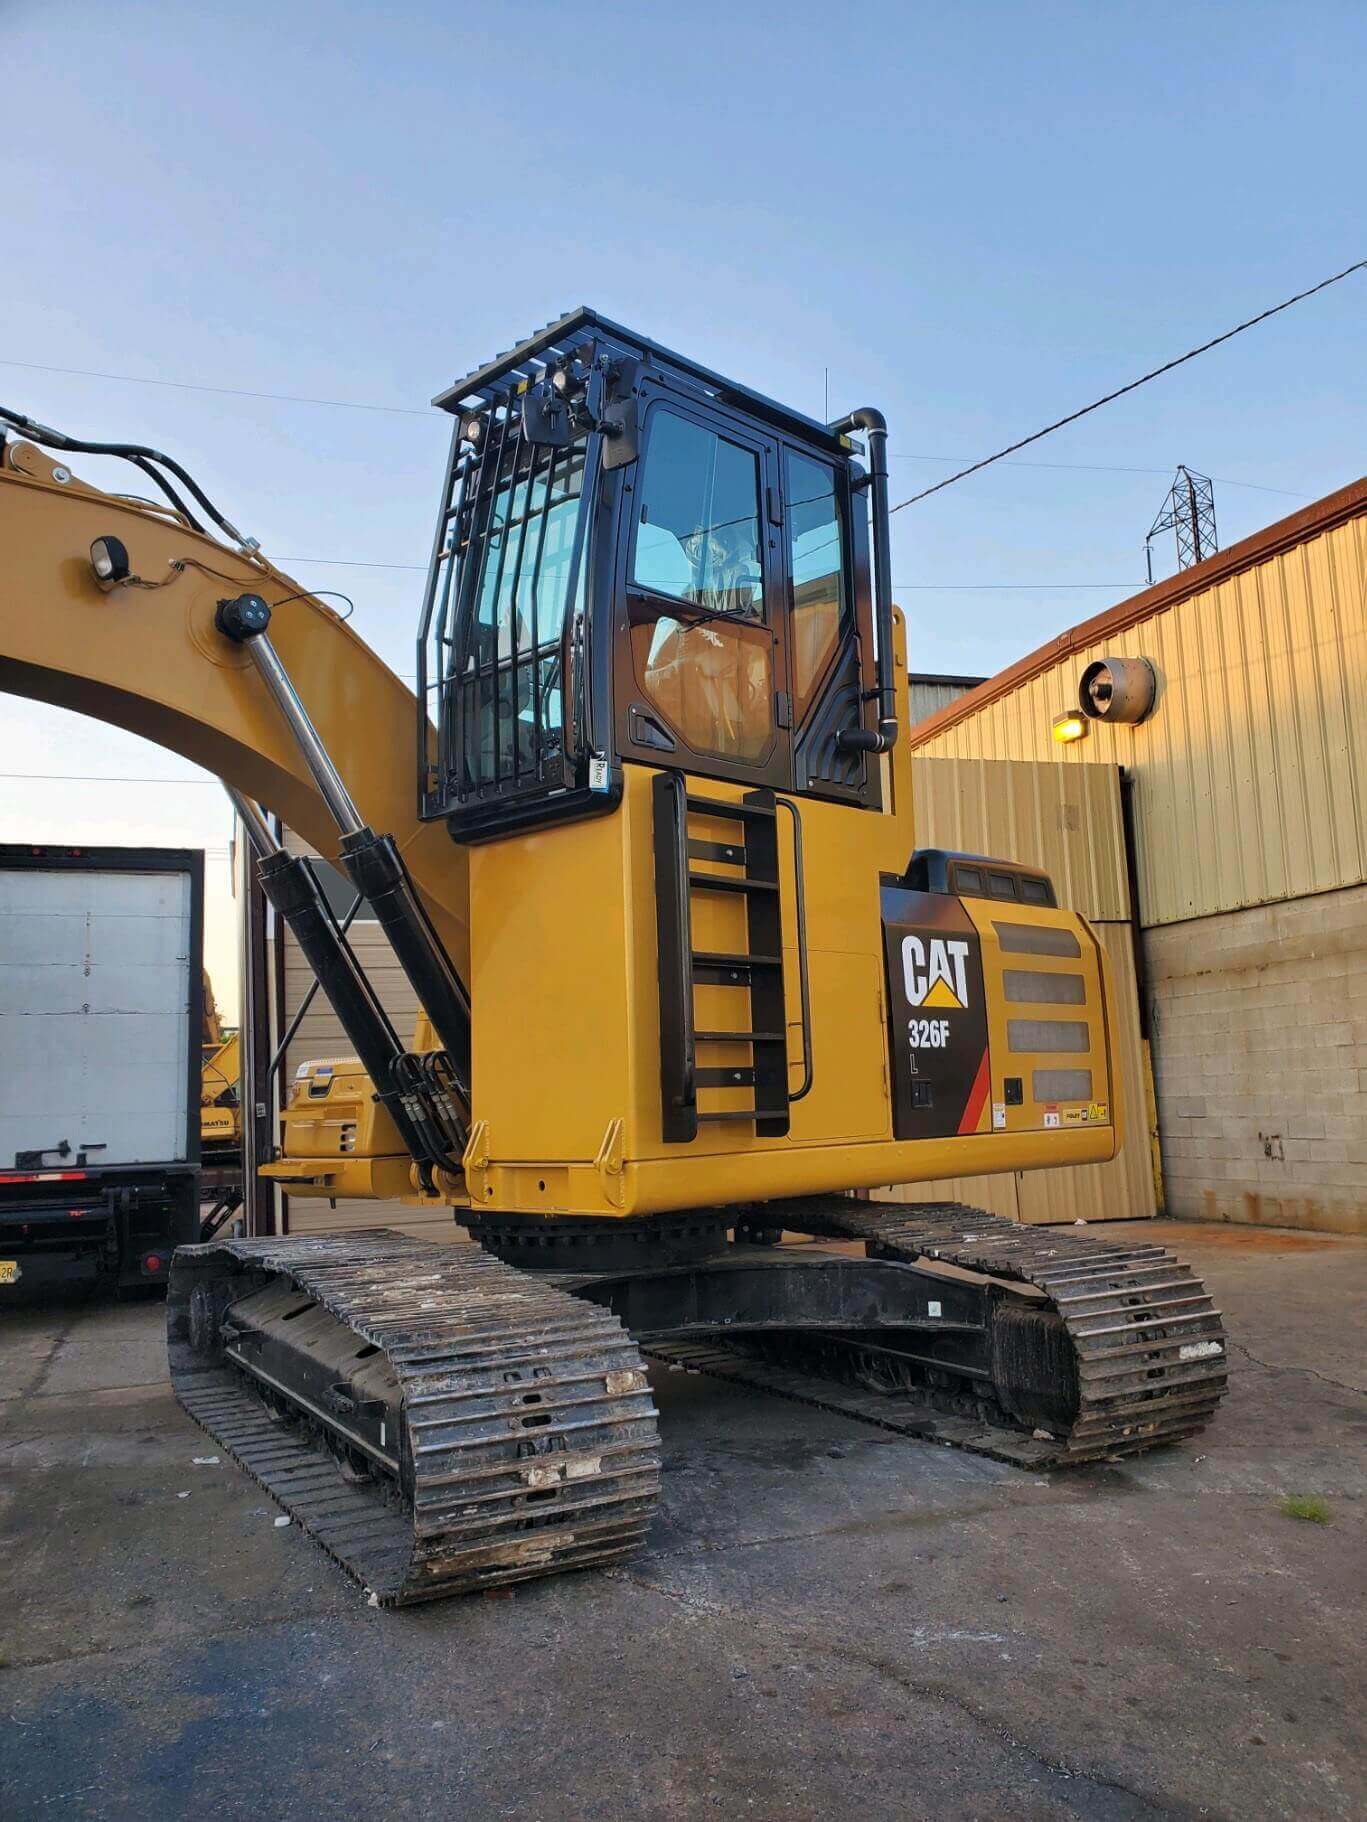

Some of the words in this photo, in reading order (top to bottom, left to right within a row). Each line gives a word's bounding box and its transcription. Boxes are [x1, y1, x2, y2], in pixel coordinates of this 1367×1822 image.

[901, 935, 969, 1009] CAT
[908, 1019, 950, 1048] 326F
[909, 1053, 919, 1075] L
